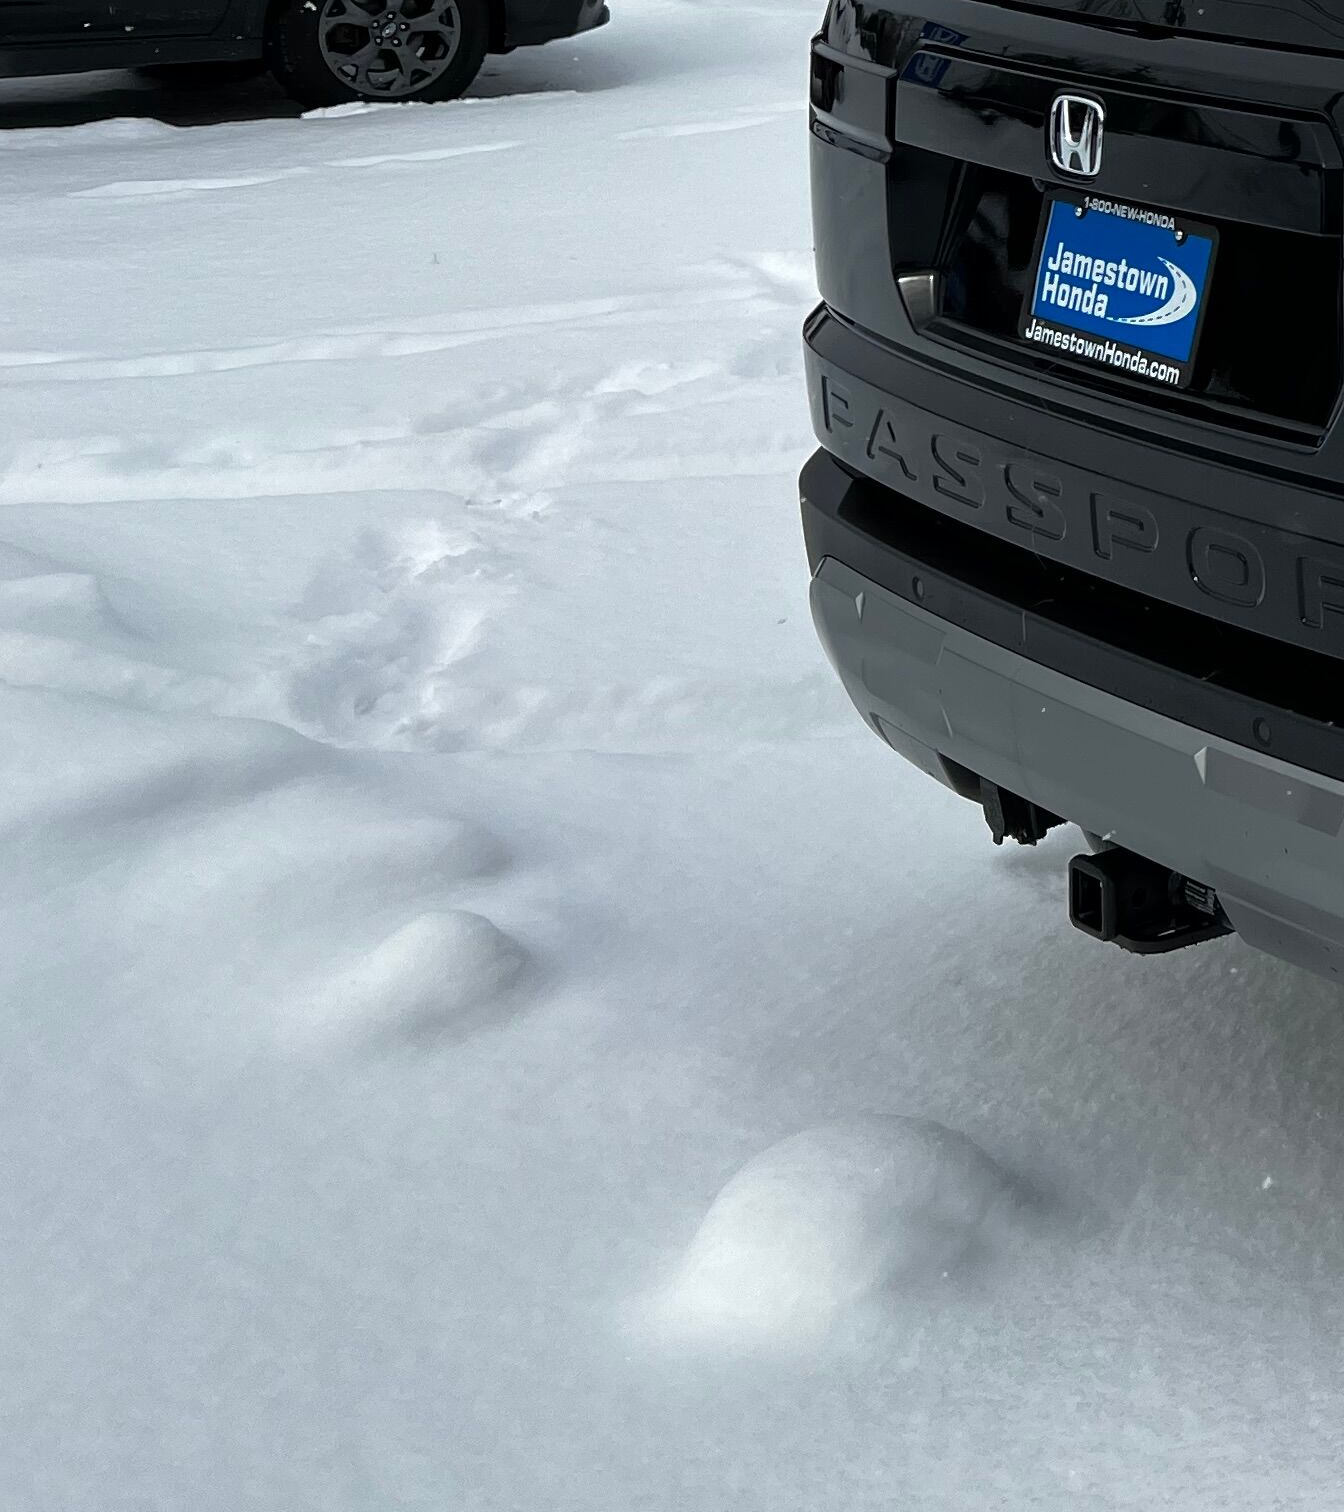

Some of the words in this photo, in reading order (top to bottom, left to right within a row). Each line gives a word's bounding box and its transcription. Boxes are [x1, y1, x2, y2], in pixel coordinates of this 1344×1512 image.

[1042, 272, 1109, 319] Honda
[1048, 242, 1169, 301] Jamestown
[1025, 319, 1180, 385] JamestownHonda.com
